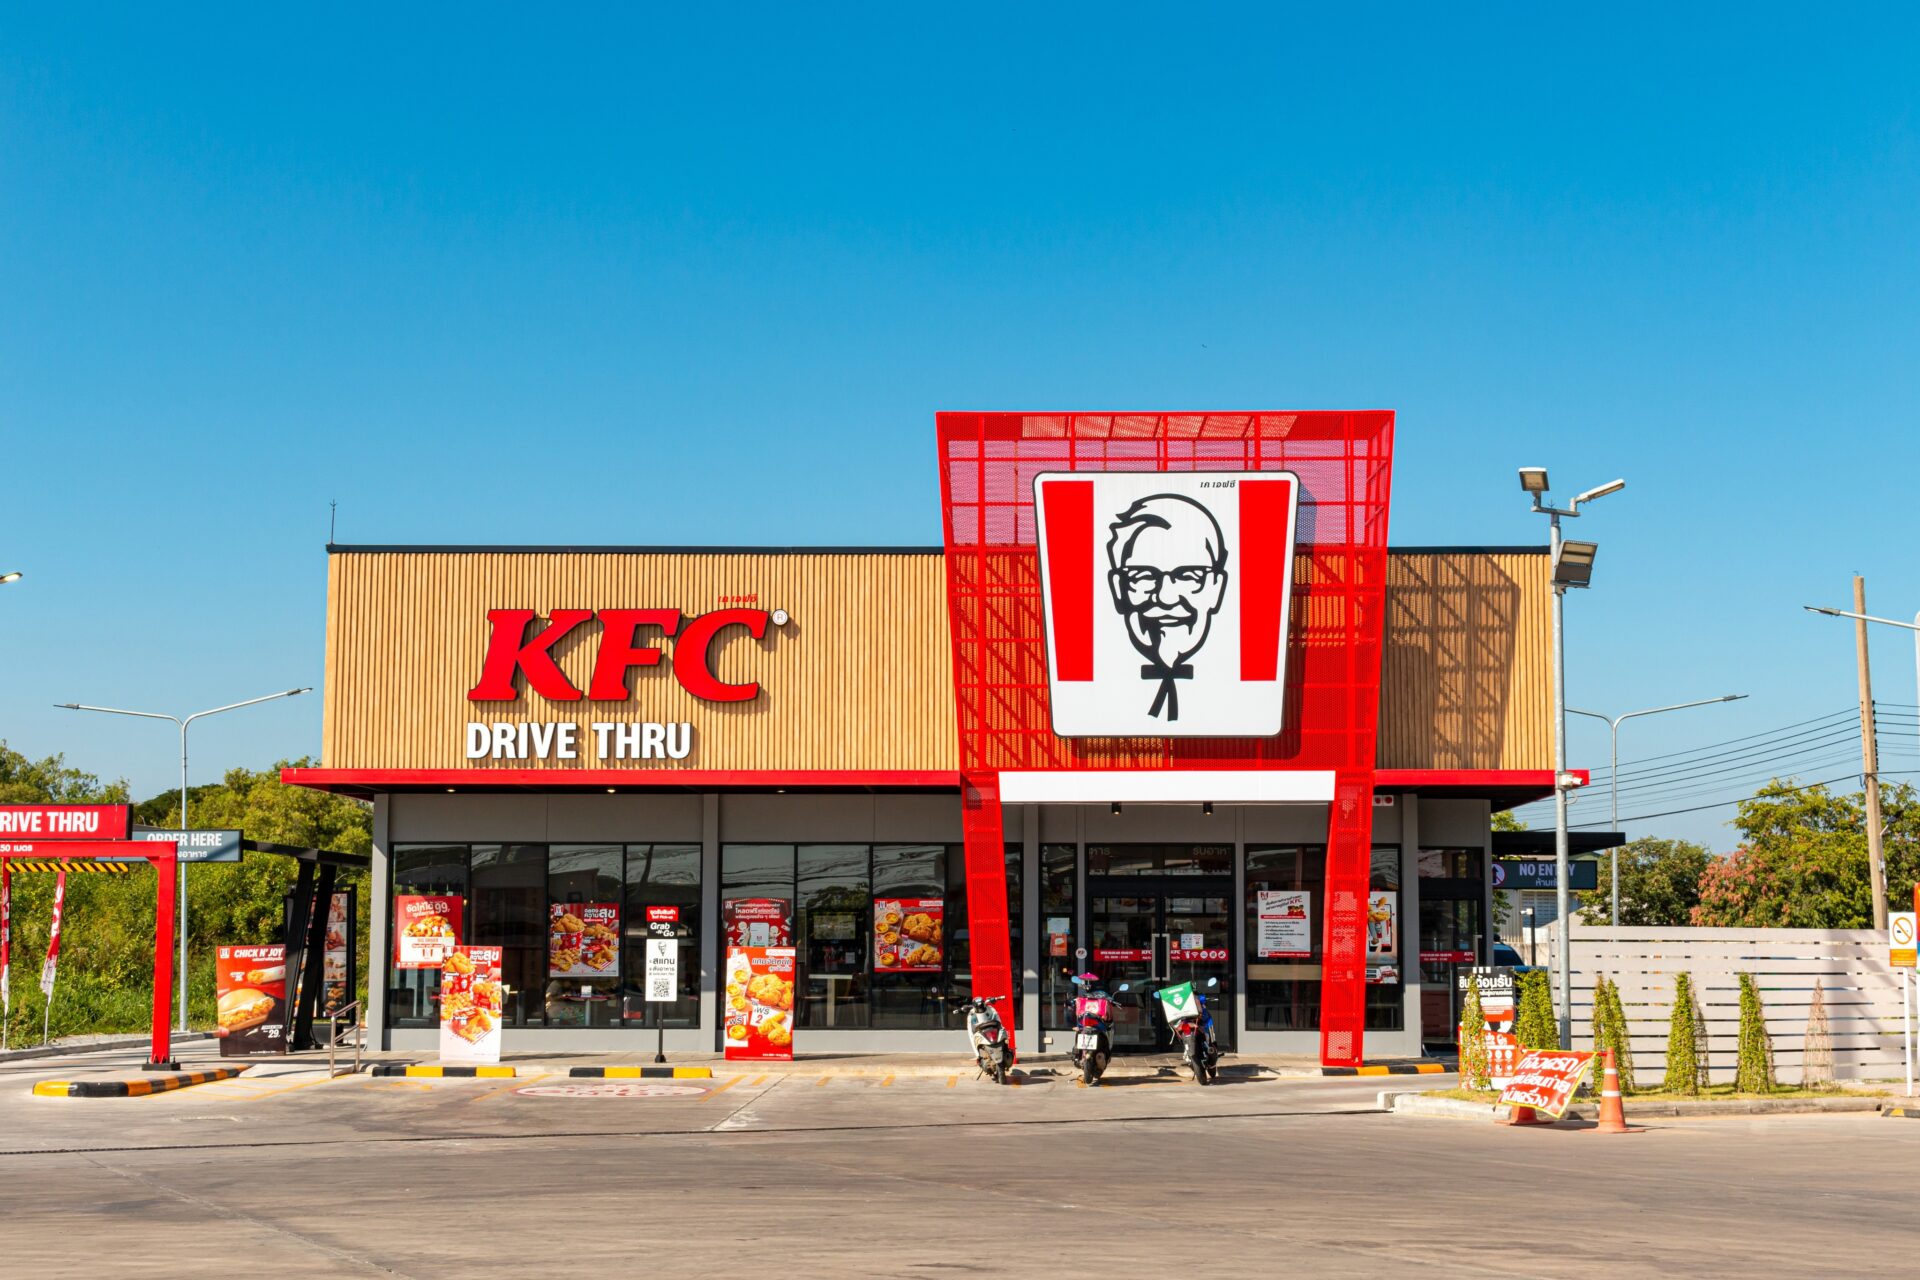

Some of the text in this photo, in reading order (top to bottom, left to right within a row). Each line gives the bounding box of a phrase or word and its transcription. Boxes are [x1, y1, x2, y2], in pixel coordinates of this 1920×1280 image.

[1212, 480, 1236, 488] เอฟซี
[467, 607, 770, 703] KFC
[466, 721, 692, 760] DRIVE THRU
[0, 811, 99, 833] RIVE THRU
[190, 832, 223, 847] HERE
[1519, 863, 1576, 876] NO ENY
[650, 922, 671, 930] Grab
[234, 948, 258, 958] CHICK
[268, 947, 284, 957] JOY
[652, 957, 675, 965] สแกน
[1458, 974, 1513, 989] ยินต้อนรับ
[755, 1014, 764, 1024] 2
